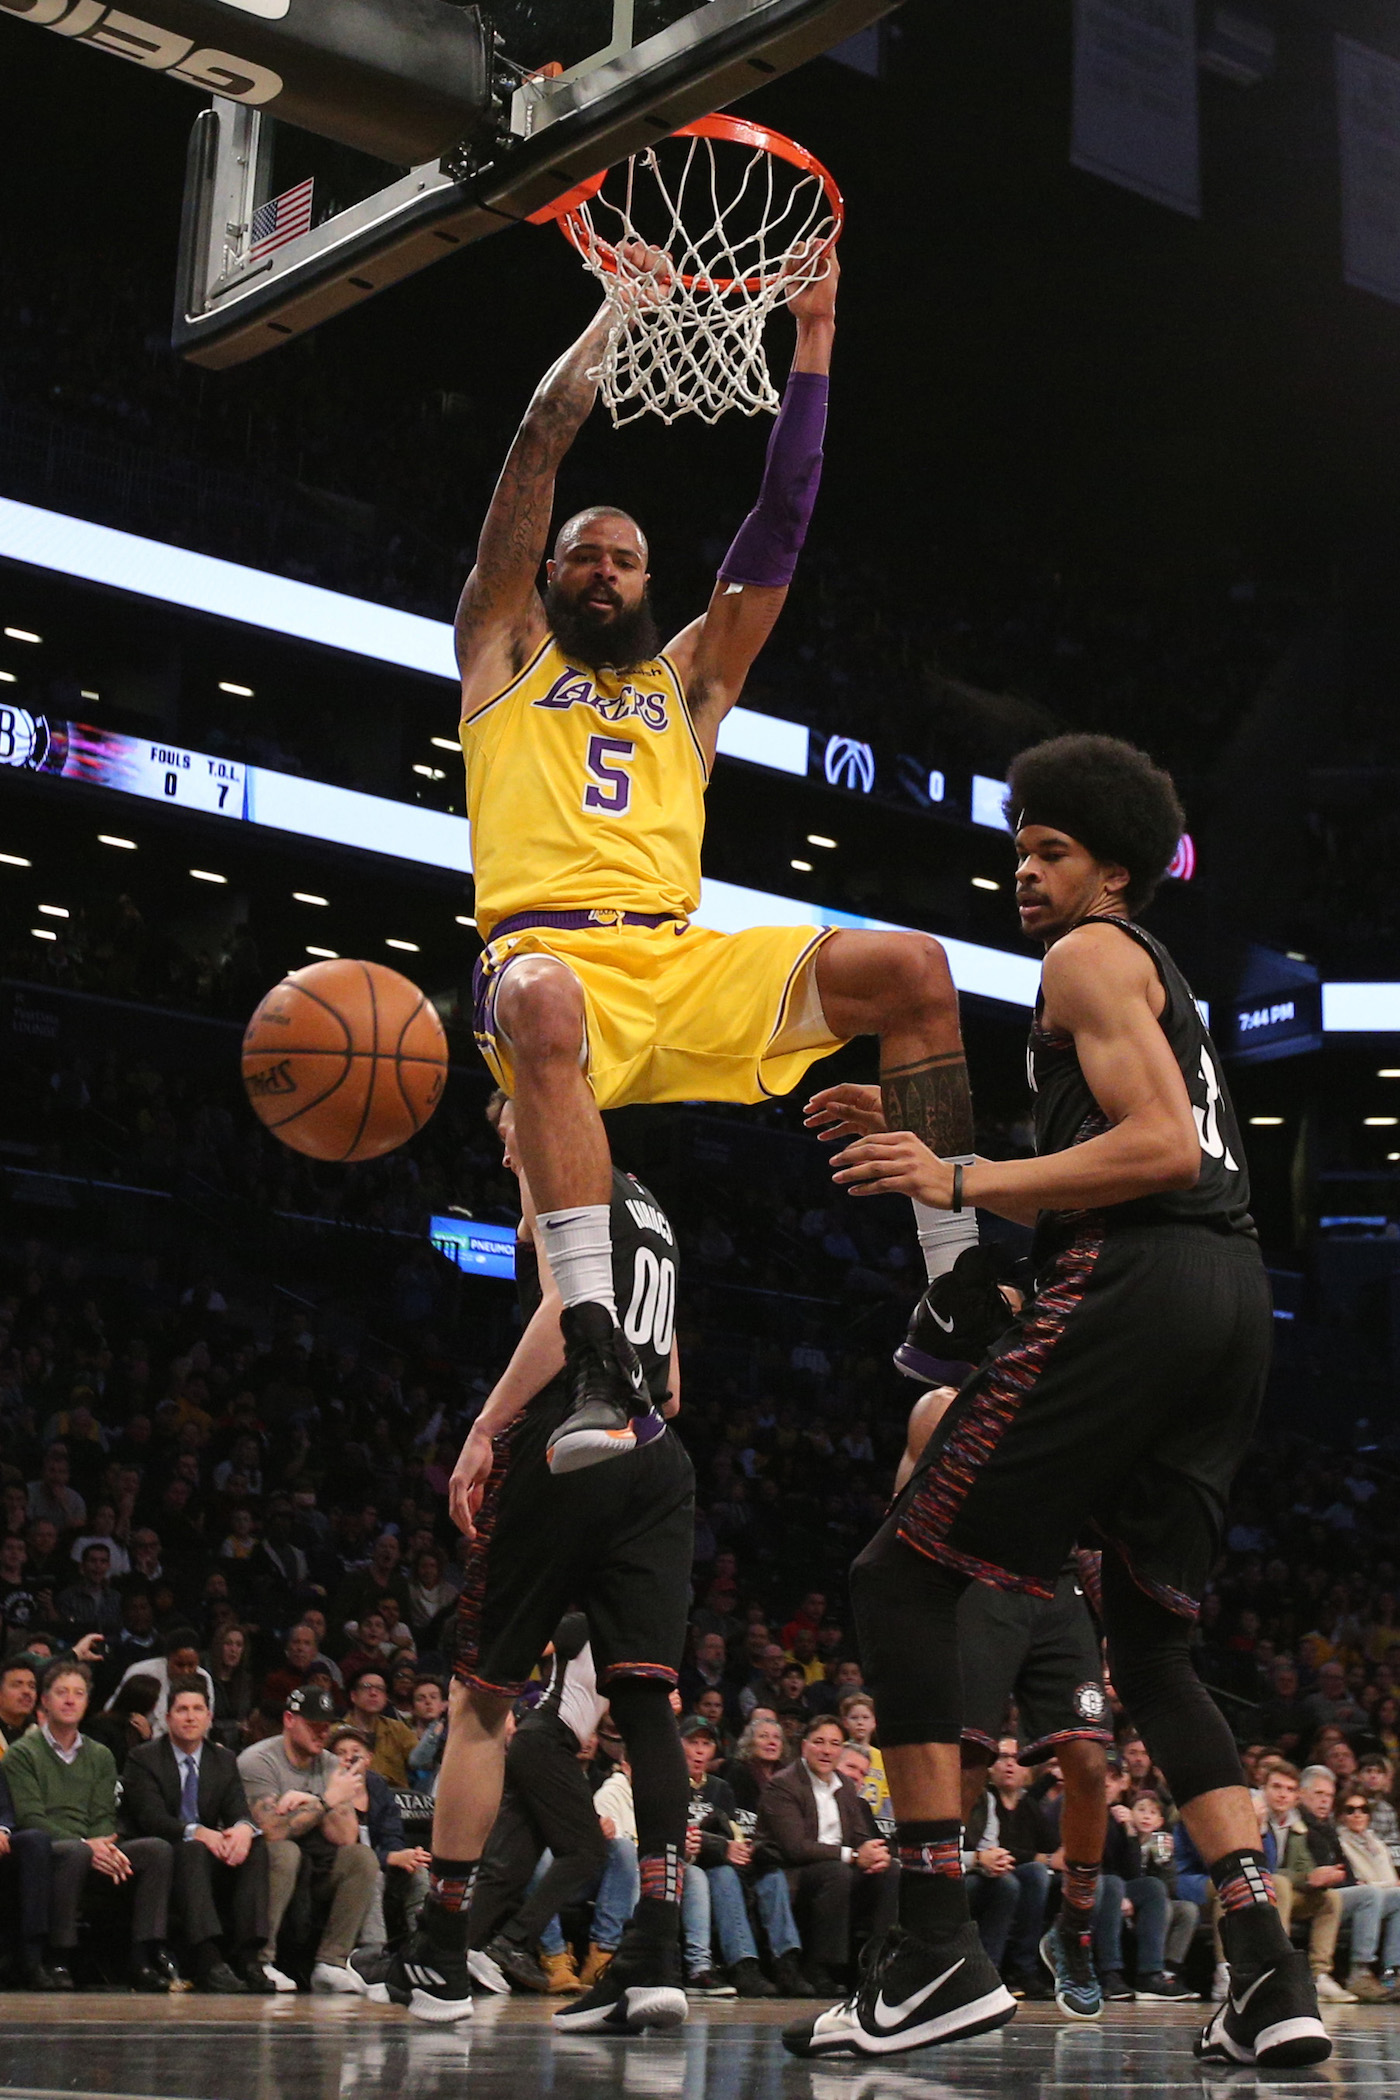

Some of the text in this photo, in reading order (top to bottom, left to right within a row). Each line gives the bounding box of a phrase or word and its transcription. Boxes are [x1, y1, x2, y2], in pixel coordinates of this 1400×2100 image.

[150, 746, 191, 770] FOULS
[582, 732, 636, 818] 5
[164, 771, 230, 809] 0 7
[928, 769, 945, 803] 0
[1238, 1007, 1270, 1032] 7:44
[1270, 1001, 1295, 1025] PM
[624, 1246, 676, 1356] 00
